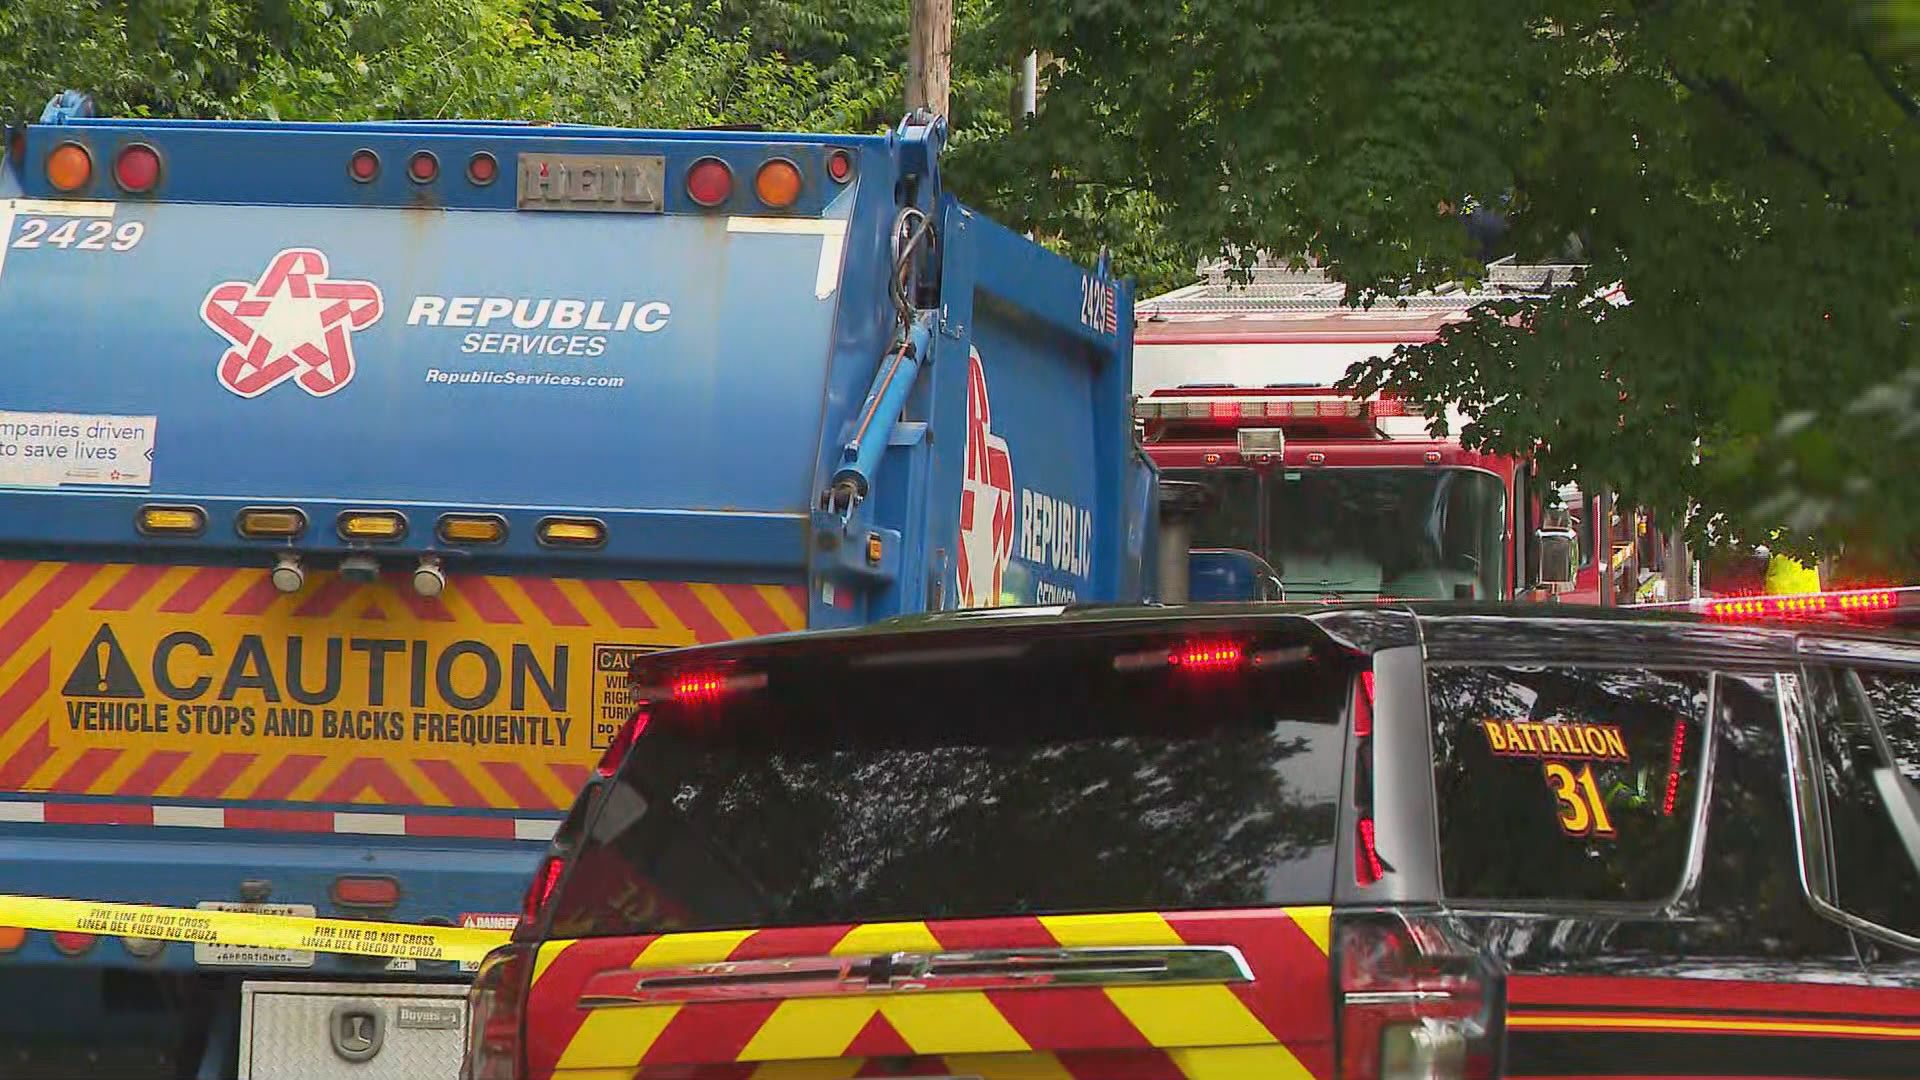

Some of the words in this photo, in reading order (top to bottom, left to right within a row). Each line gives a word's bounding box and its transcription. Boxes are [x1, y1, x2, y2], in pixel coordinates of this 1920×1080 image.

[12, 219, 145, 251] 2429
[406, 295, 671, 332] REPUBLIC
[1080, 273, 1106, 334] 2429
[460, 333, 607, 356] SERVICES
[425, 369, 624, 388] RepublicServices.com
[86, 421, 145, 440] driven
[24, 444, 68, 458] save
[74, 441, 118, 460] lives
[1020, 487, 1092, 580] REPUBLIC
[152, 631, 569, 712] CAUTION
[67, 701, 169, 732] VEHICLE
[176, 705, 255, 736] STOPS
[263, 707, 313, 738] AND
[322, 710, 404, 741] BACKS
[413, 713, 572, 747] FREQUENTLY
[1483, 720, 1629, 760] BATTALION
[1545, 762, 1615, 836] 31
[76, 918, 108, 930] LINEA
[110, 920, 128, 933] DEL
[131, 923, 164, 937] FUEGO
[165, 927, 181, 938] NO
[183, 928, 218, 940] CRUZA
[90, 909, 113, 920] FIRE
[114, 910, 137, 921] LINE
[139, 913, 153, 923] DO
[155, 915, 177, 926] NOT
[178, 917, 212, 929] CROSS
[301, 936, 332, 949] LINEA
[334, 939, 353, 951] DEL
[356, 941, 389, 954] FUEGO
[390, 944, 407, 955] NO
[408, 946, 443, 958] CRUZA
[314, 926, 337, 938] FIRE
[338, 928, 361, 939] LINE
[364, 930, 378, 941] DO
[380, 932, 401, 943] NOT
[402, 934, 436, 946] CROSS
[393, 961, 408, 969] KIT
